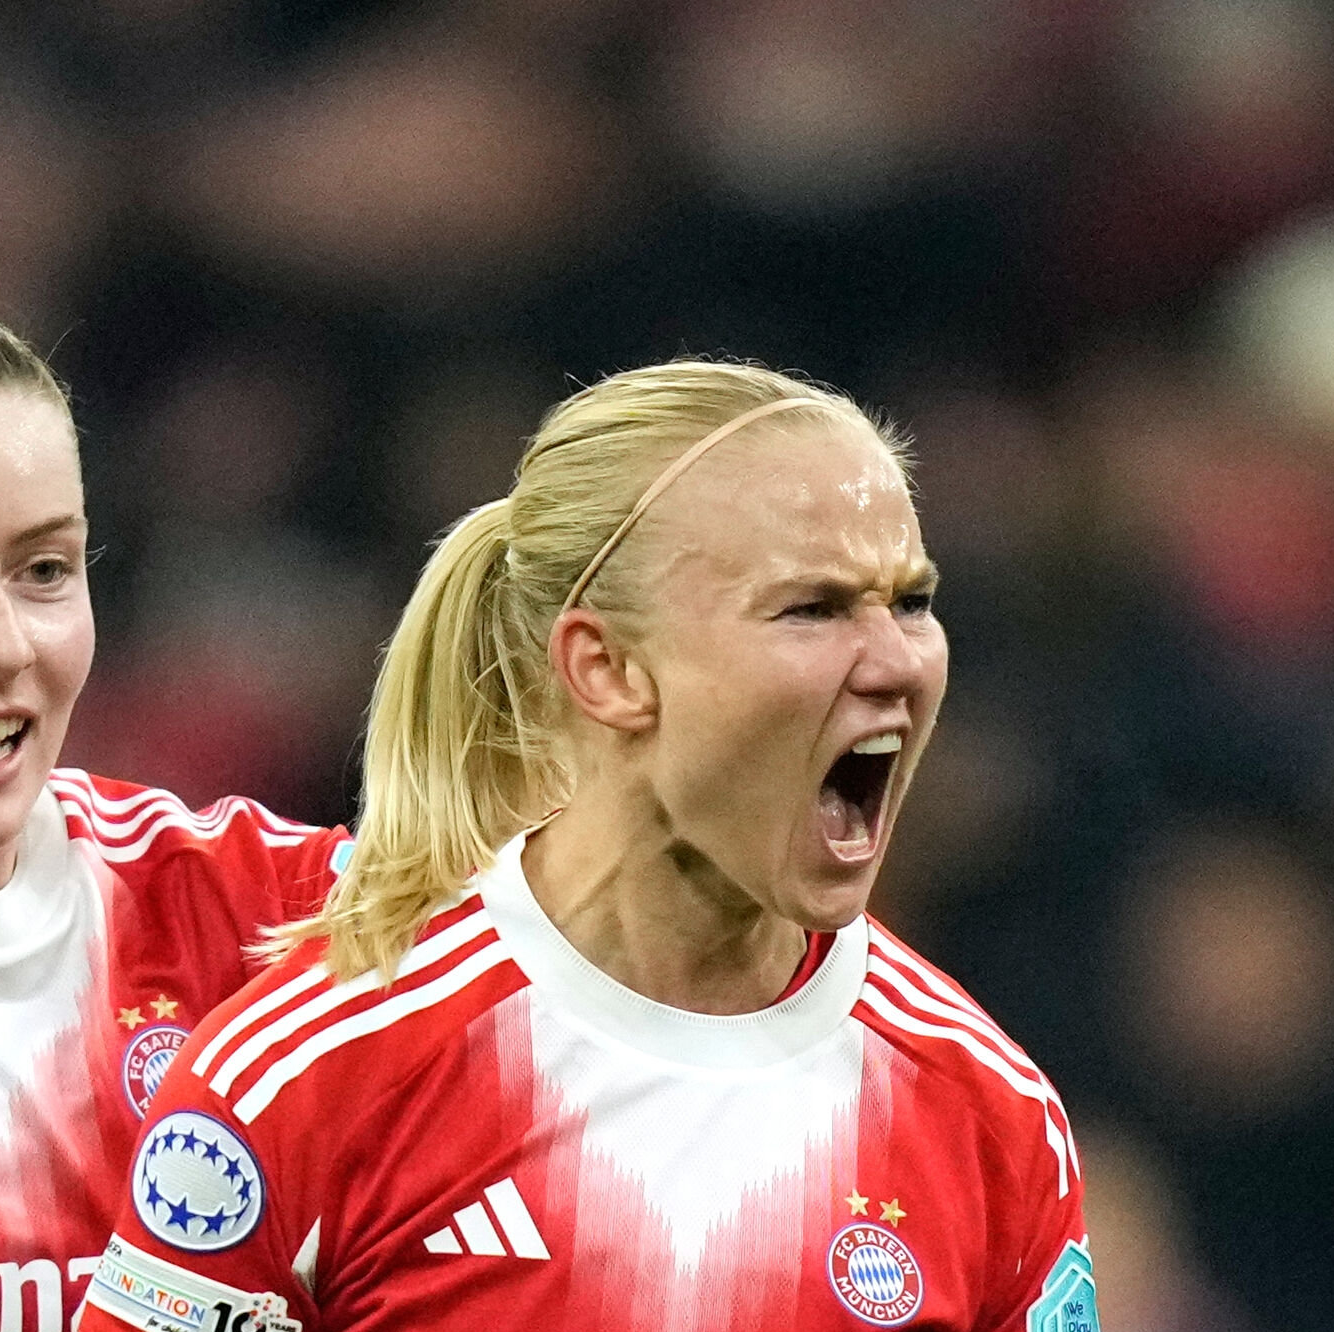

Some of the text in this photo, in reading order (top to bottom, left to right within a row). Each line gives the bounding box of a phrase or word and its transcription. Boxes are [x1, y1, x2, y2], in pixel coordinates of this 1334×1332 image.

[129, 1034, 183, 1080] FC BAYE
[835, 1230, 916, 1275] FC BAYERN
[836, 1276, 916, 1319] MÜNCHEN
[1067, 1300, 1083, 1316] We
